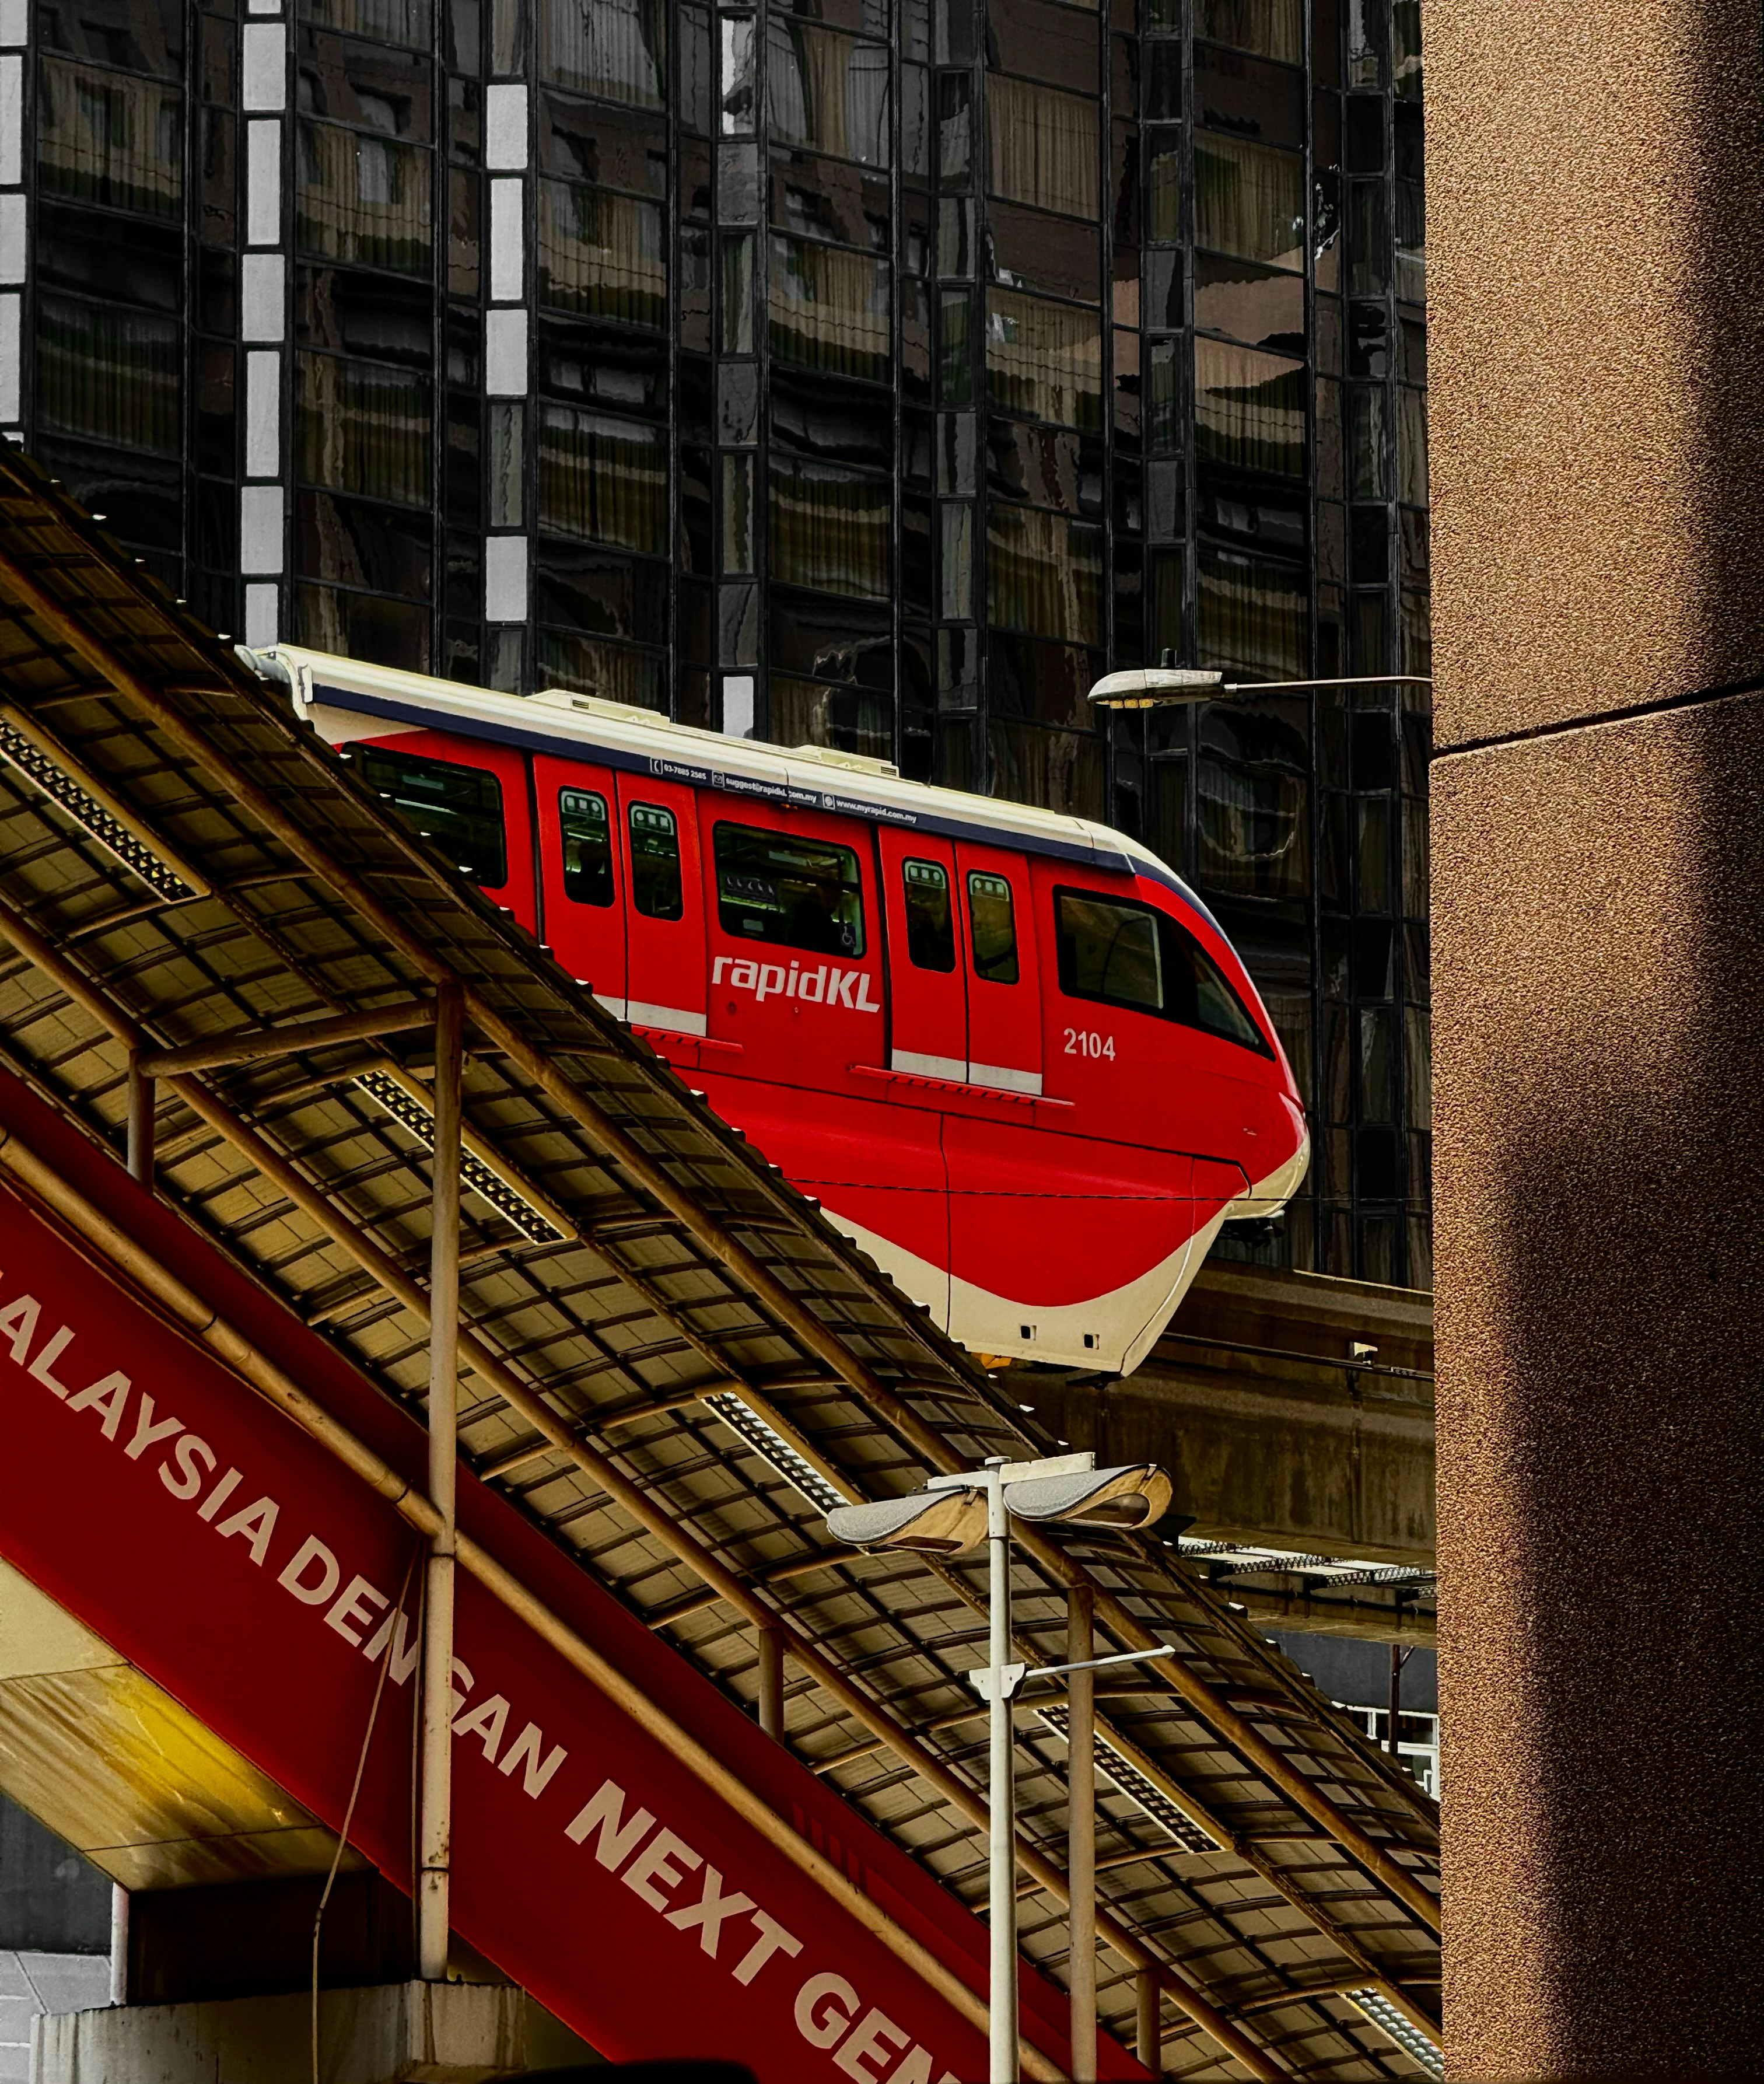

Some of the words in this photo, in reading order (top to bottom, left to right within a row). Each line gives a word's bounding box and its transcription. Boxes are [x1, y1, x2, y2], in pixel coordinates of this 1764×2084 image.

[836, 800, 917, 823] www.myrapid.com.my
[712, 956, 881, 1013] rapidKL
[1063, 1028, 1116, 1061] 2104
[0, 1270, 279, 1567] ALAYSIA
[564, 1779, 804, 1986] NEXT
